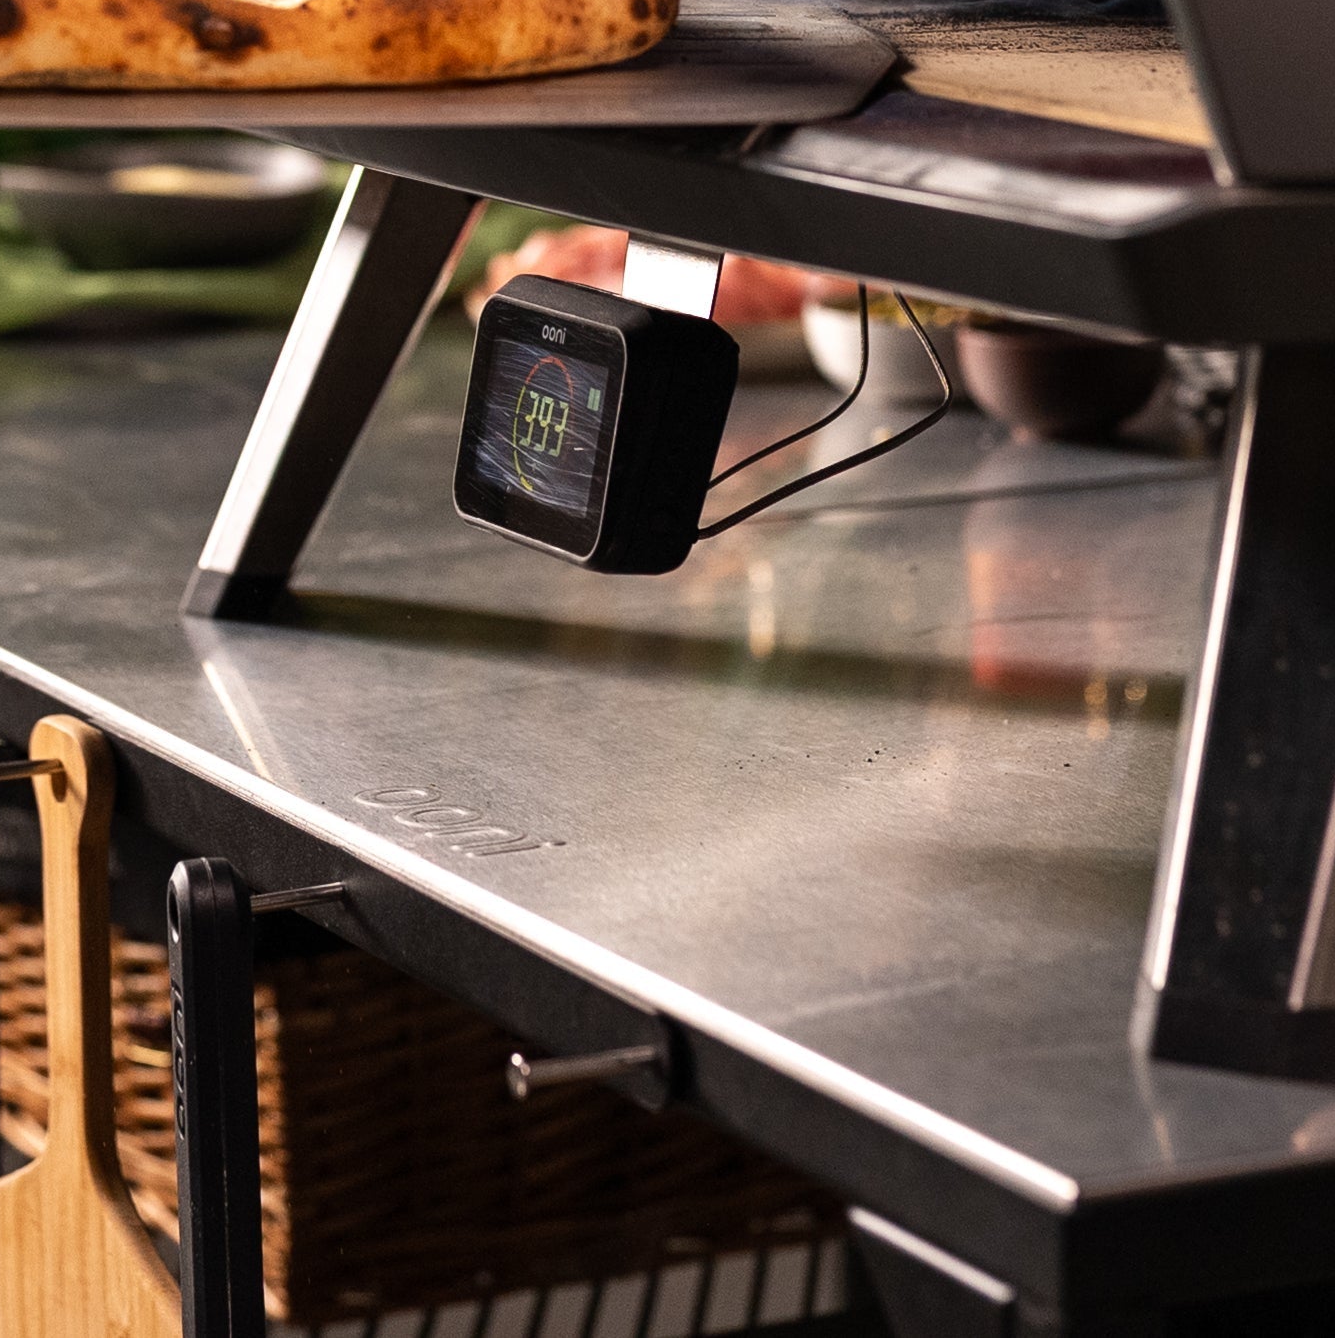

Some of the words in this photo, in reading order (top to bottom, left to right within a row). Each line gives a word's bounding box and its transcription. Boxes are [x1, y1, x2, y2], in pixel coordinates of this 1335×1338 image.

[542, 324, 567, 344] ooni
[519, 390, 569, 458] 393
[353, 785, 567, 858] ooni
